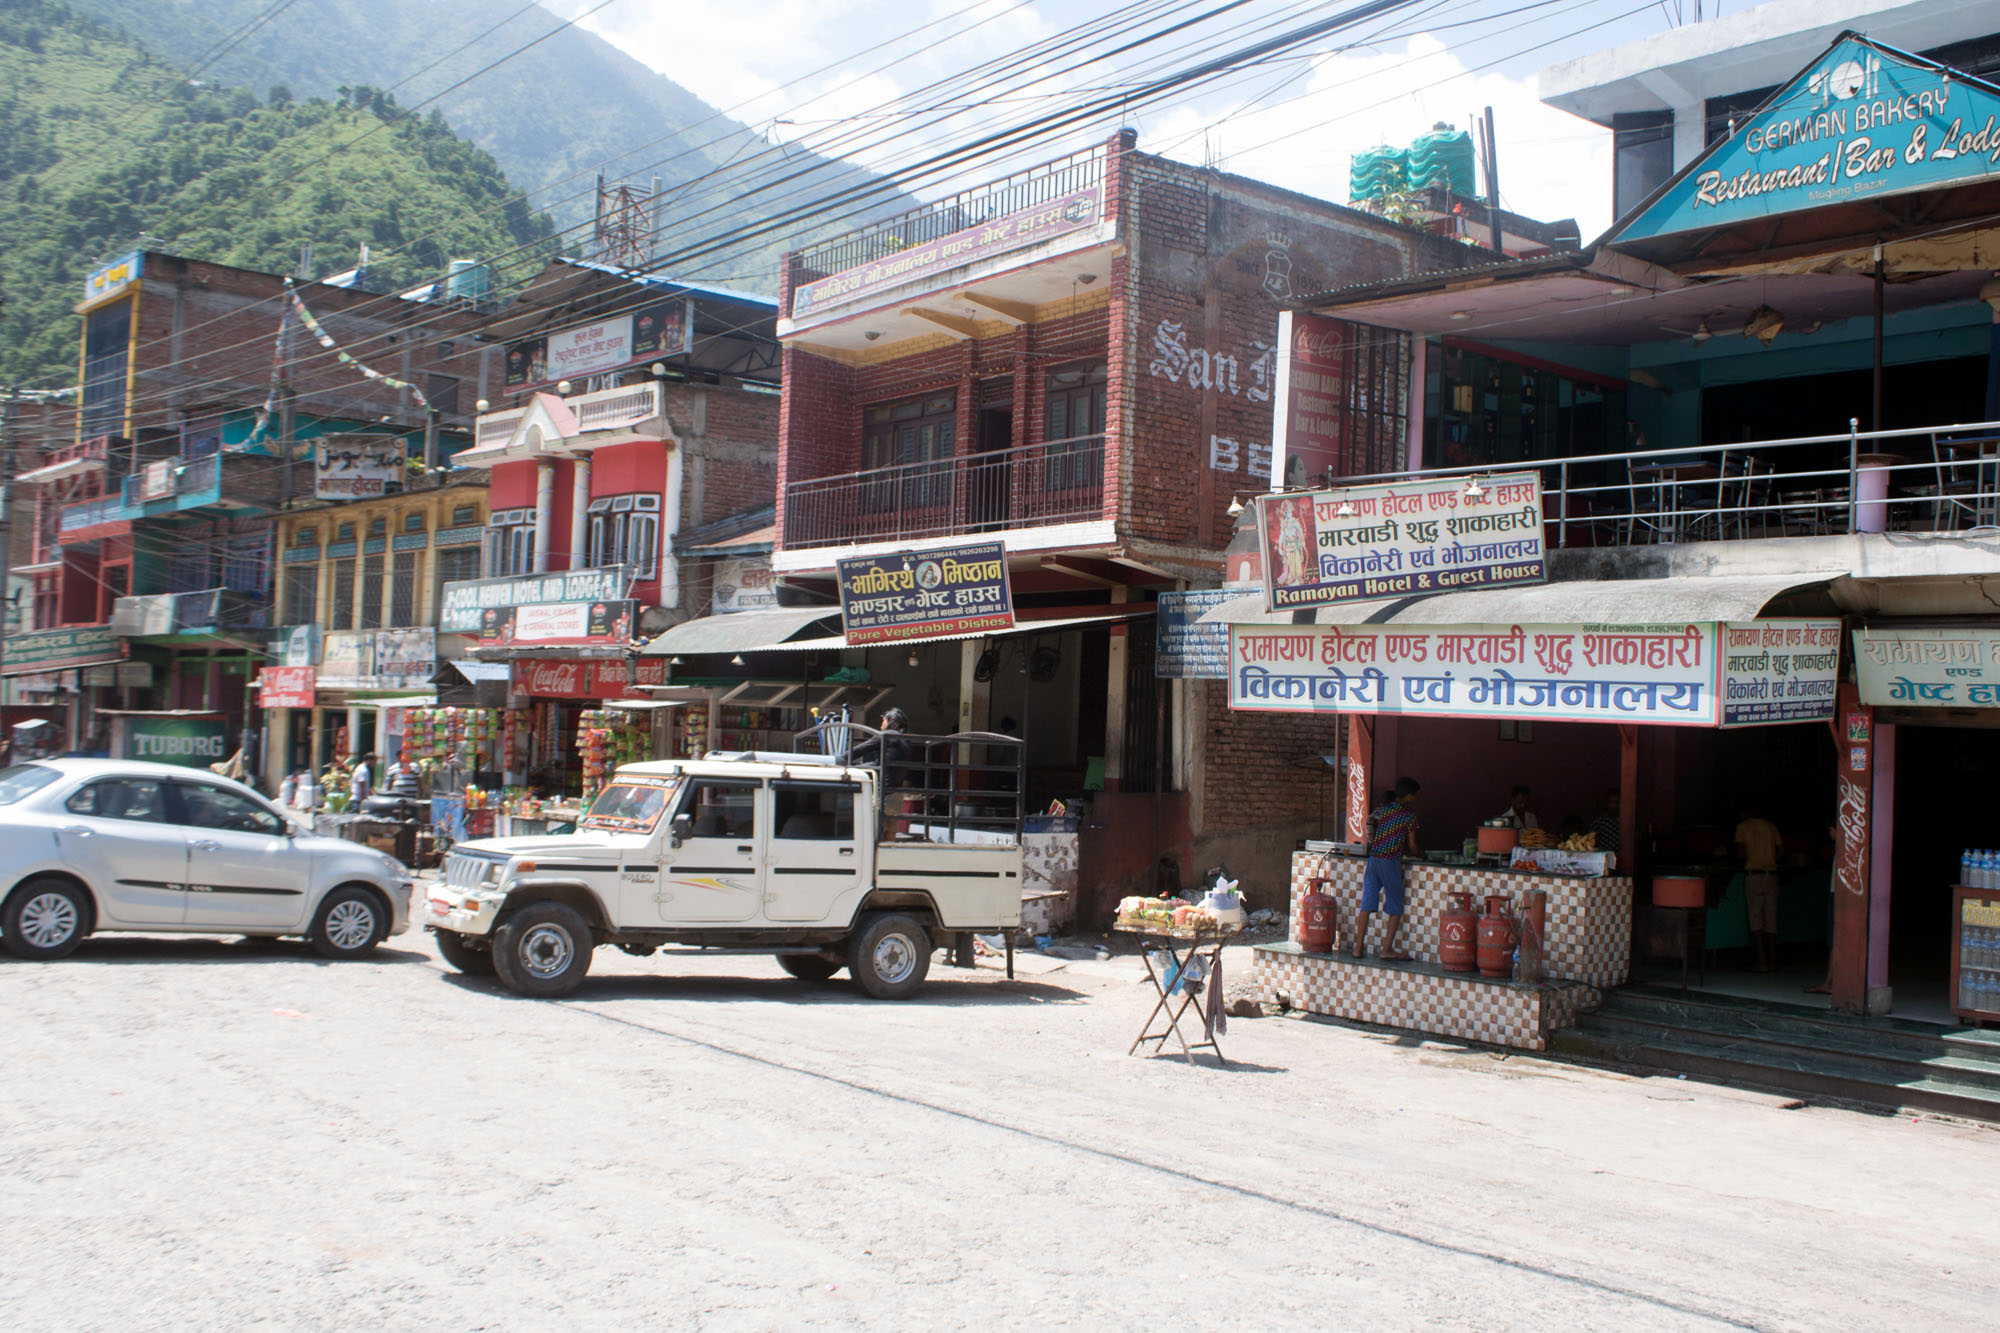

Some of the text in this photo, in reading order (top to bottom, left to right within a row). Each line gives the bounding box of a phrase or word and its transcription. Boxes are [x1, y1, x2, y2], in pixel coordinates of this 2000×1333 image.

[1745, 88, 1949, 154] GERMAN BAKERY
[1904, 125, 1927, 162] &
[1931, 114, 2000, 164] Lodg
[1809, 178, 1887, 202] Mugling Bazar
[865, 249, 938, 286] भोजनालय
[1297, 274, 1322, 291] 1890
[1150, 319, 1240, 396] San
[1321, 375, 1347, 397] BAKE
[1317, 416, 1339, 439] Lodge
[1382, 489, 1422, 517] होटल
[1428, 490, 1458, 510] एण्ड
[1497, 483, 1535, 504] हाउस
[1318, 506, 1538, 548] मारवाडी शुद्ध शाकाहारी
[1320, 538, 1540, 577] विकानेरी एवं भोजनालय
[565, 574, 600, 600] LODGE
[851, 567, 915, 595] भागिरथ
[1276, 564, 1540, 605] Ramayan Hotel & Guest House
[850, 595, 905, 616] भण्डार
[915, 589, 950, 608] गेष्ट
[955, 585, 1001, 606] हाउस
[849, 616, 1010, 642] Pure Vegetable Dishes.
[1728, 628, 1760, 648] रामायण
[1762, 623, 1784, 648] होटल
[1786, 628, 1801, 647] एण्ड
[1819, 627, 1839, 648] हाउस
[1239, 625, 1703, 675] रामायण होटल एण्ड मारवाडी शुद्ध शाकाहारी
[1727, 651, 1770, 672] मारवाडी
[1792, 649, 1837, 672] शाकाहारी
[1863, 639, 1983, 666] रामायण
[532, 662, 578, 693] Coca-Cola
[1944, 667, 1984, 678] एण्ड
[1239, 665, 1705, 711] विकानेरी एवं भोजनालय
[1727, 675, 1835, 700] विकानेरी एवं भोजनालय
[1888, 676, 2000, 704] गेष्ट हा
[133, 733, 225, 757] TUBORG
[1348, 757, 1365, 837] Coca-Cola
[1837, 775, 1868, 896] Coca-Cola
